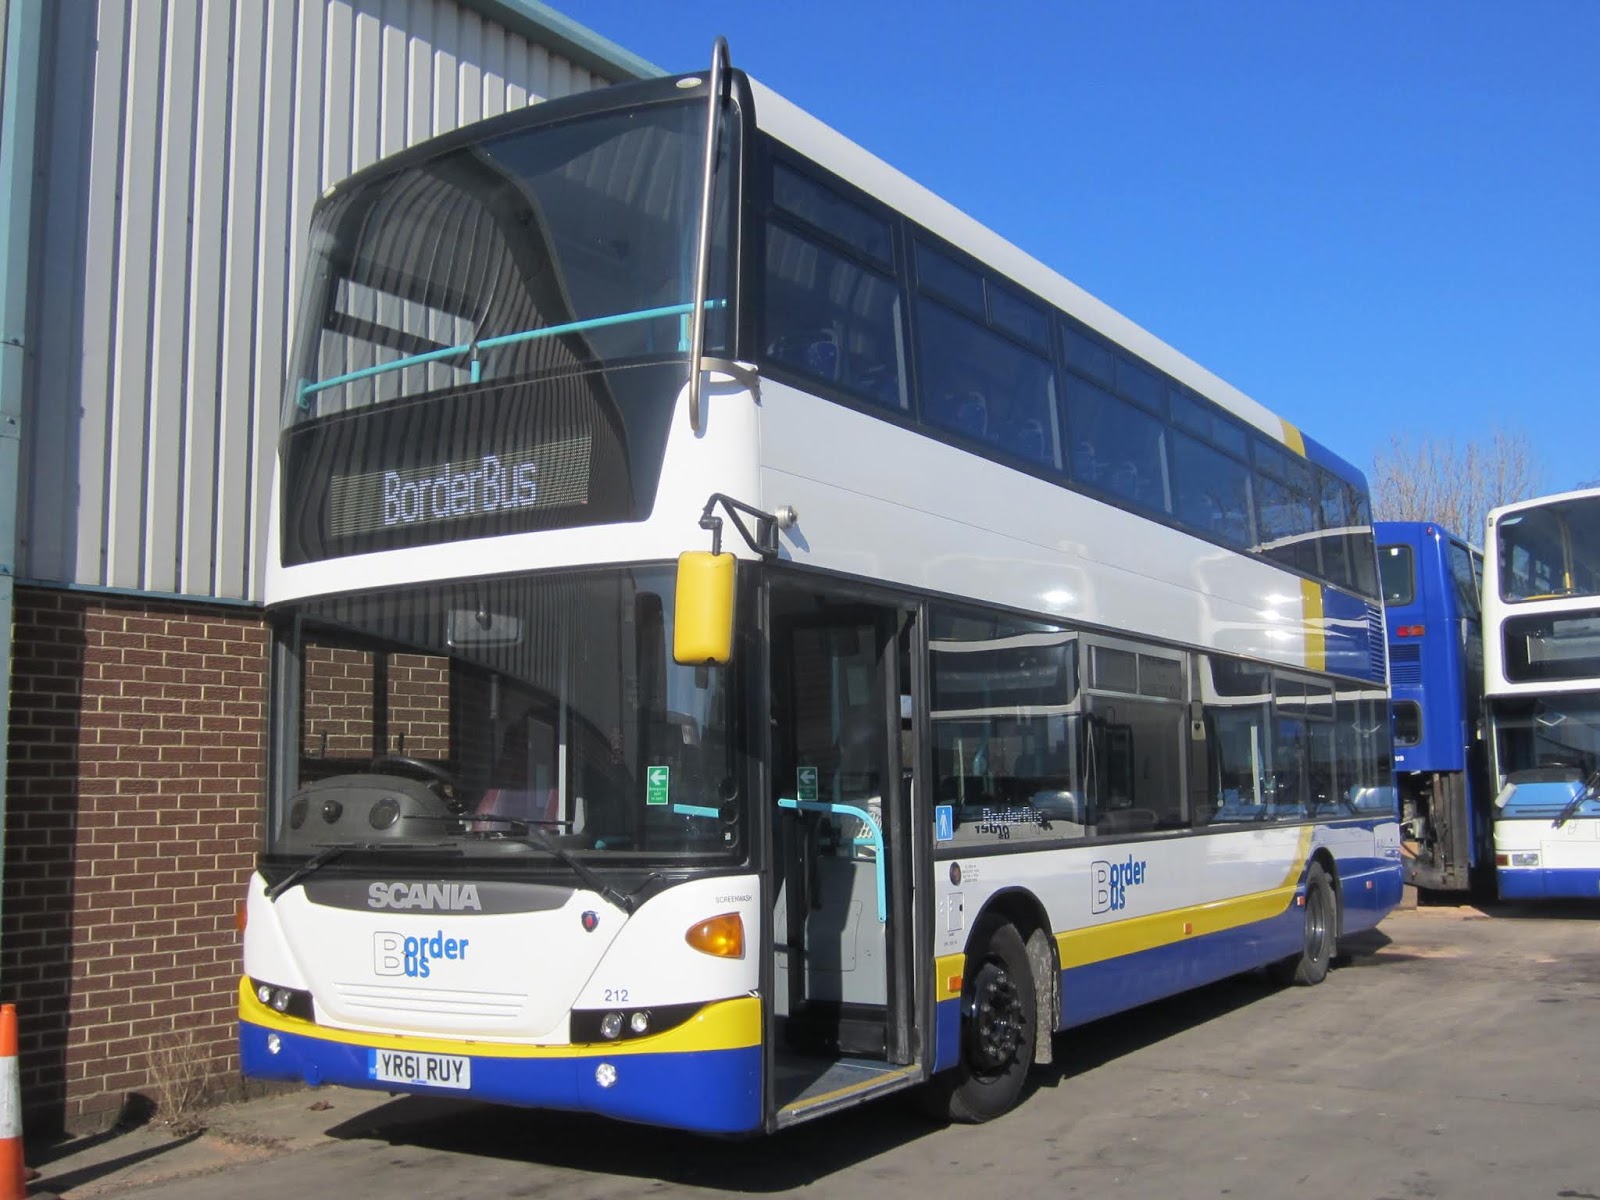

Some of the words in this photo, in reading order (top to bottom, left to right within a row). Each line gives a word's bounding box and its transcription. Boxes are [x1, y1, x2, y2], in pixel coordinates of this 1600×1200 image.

[384, 455, 536, 525] BorderBus
[367, 881, 482, 911] SCANIA
[373, 930, 470, 977] Border
[604, 989, 630, 1002] 212
[382, 1053, 421, 1079] YR61
[427, 1058, 463, 1083] RUY
